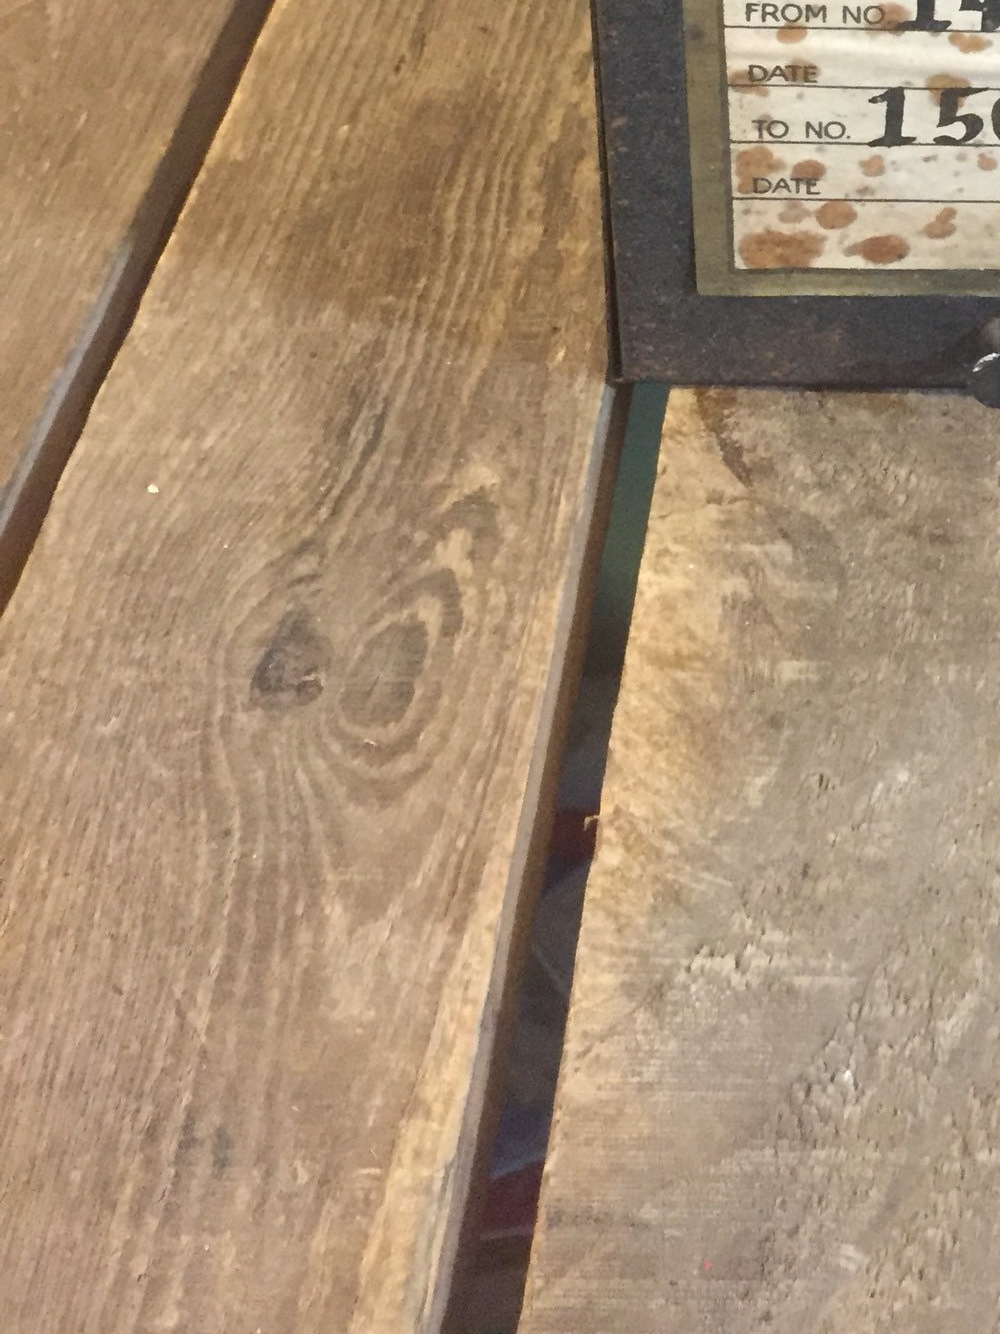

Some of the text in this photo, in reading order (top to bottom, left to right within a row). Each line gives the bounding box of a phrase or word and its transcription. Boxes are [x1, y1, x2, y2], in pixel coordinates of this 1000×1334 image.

[745, 2, 828, 24] FROM
[747, 64, 818, 83] DATE
[751, 119, 790, 139] TO
[804, 119, 852, 140] NO.
[753, 176, 821, 195] DATE
